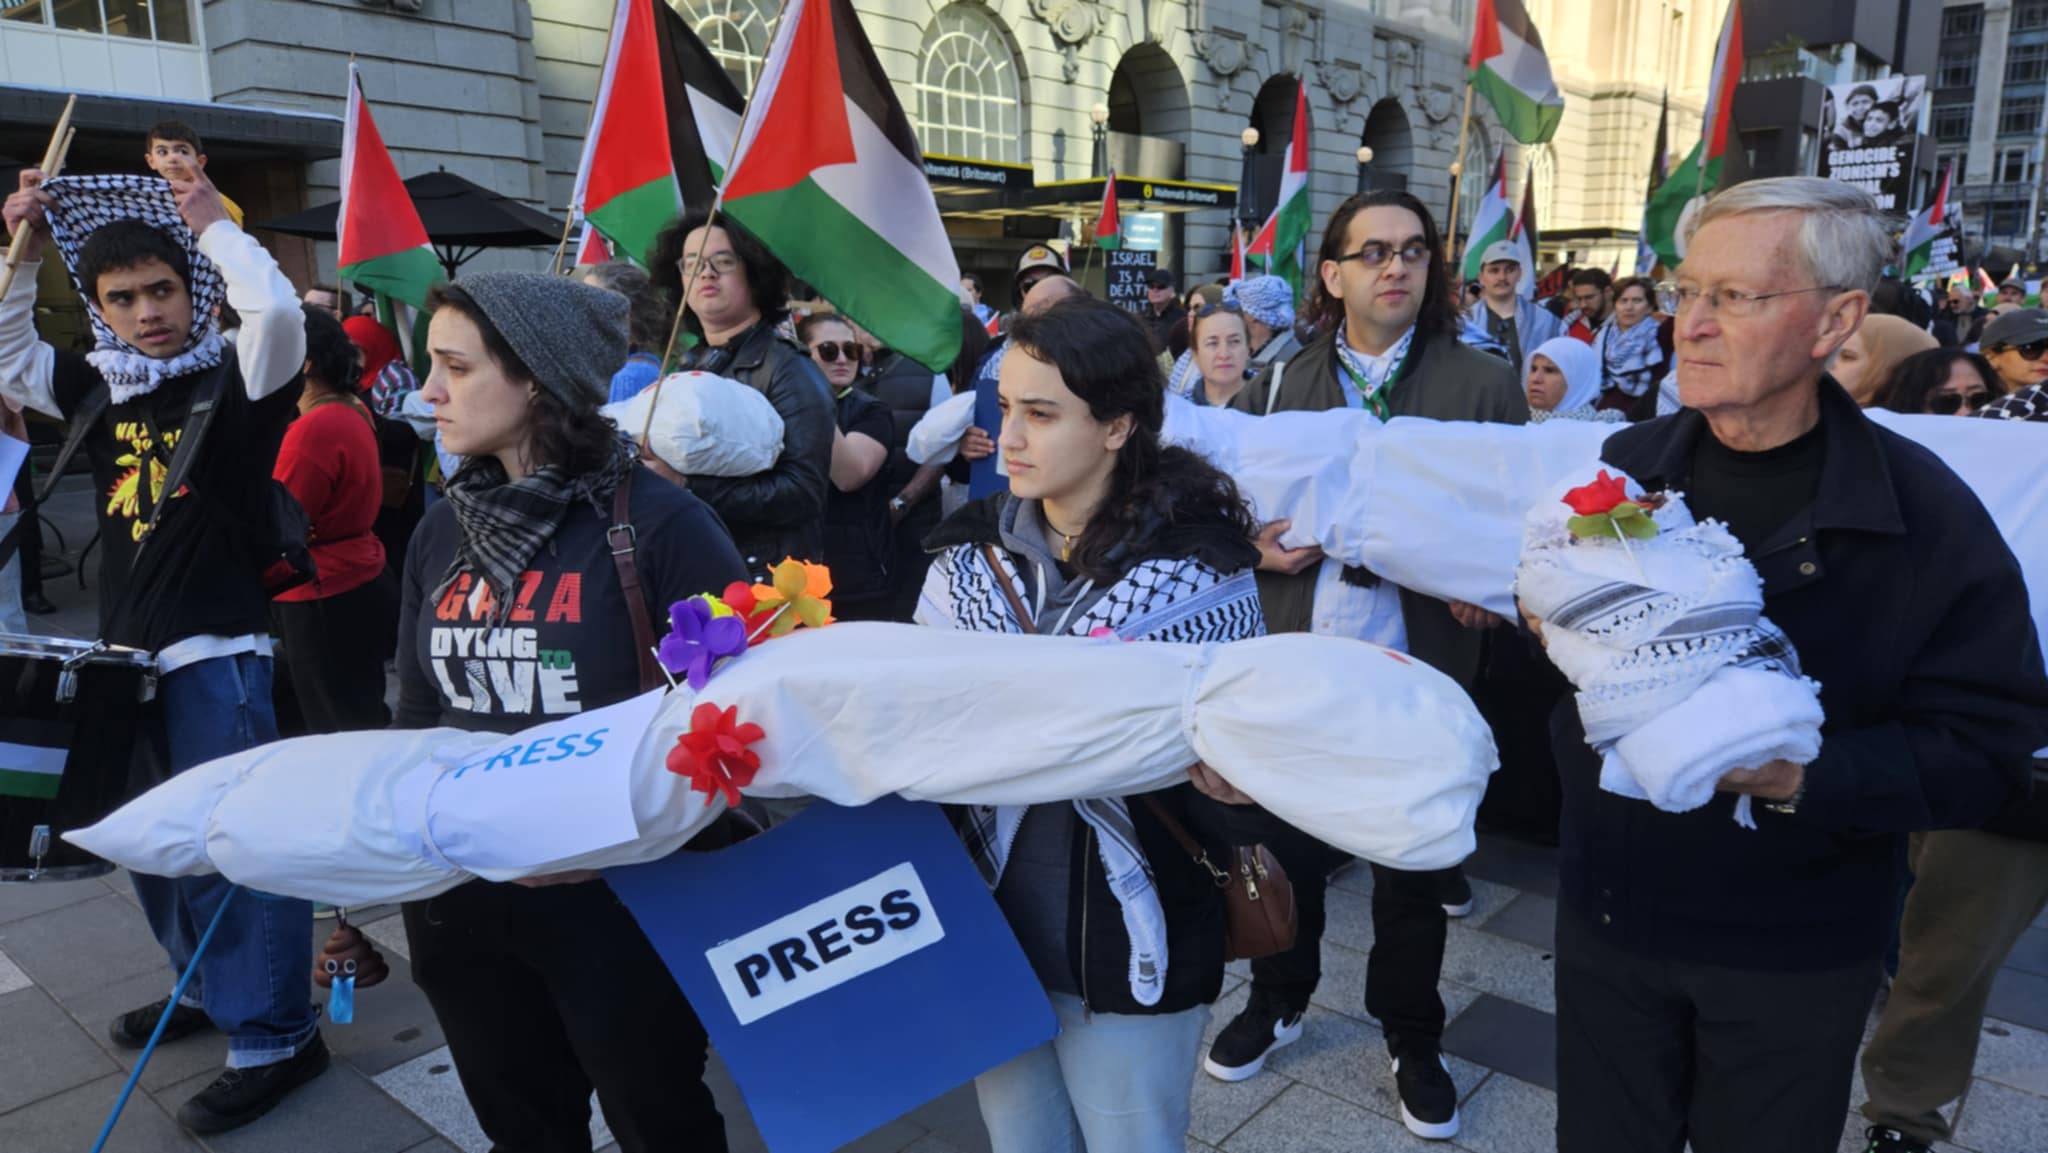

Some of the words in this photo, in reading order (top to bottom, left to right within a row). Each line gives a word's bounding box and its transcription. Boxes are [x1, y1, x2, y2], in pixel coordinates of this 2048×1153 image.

[1828, 146, 1897, 166] GENOCIDE
[1111, 252, 1156, 266] ISRAEL
[1118, 270, 1133, 283] IS
[1136, 271, 1145, 283] A
[436, 571, 582, 623] GAZA
[430, 627, 537, 659] DYING
[539, 650, 573, 669] TO
[431, 658, 583, 714] LIVE
[734, 889, 921, 998] PRESS
